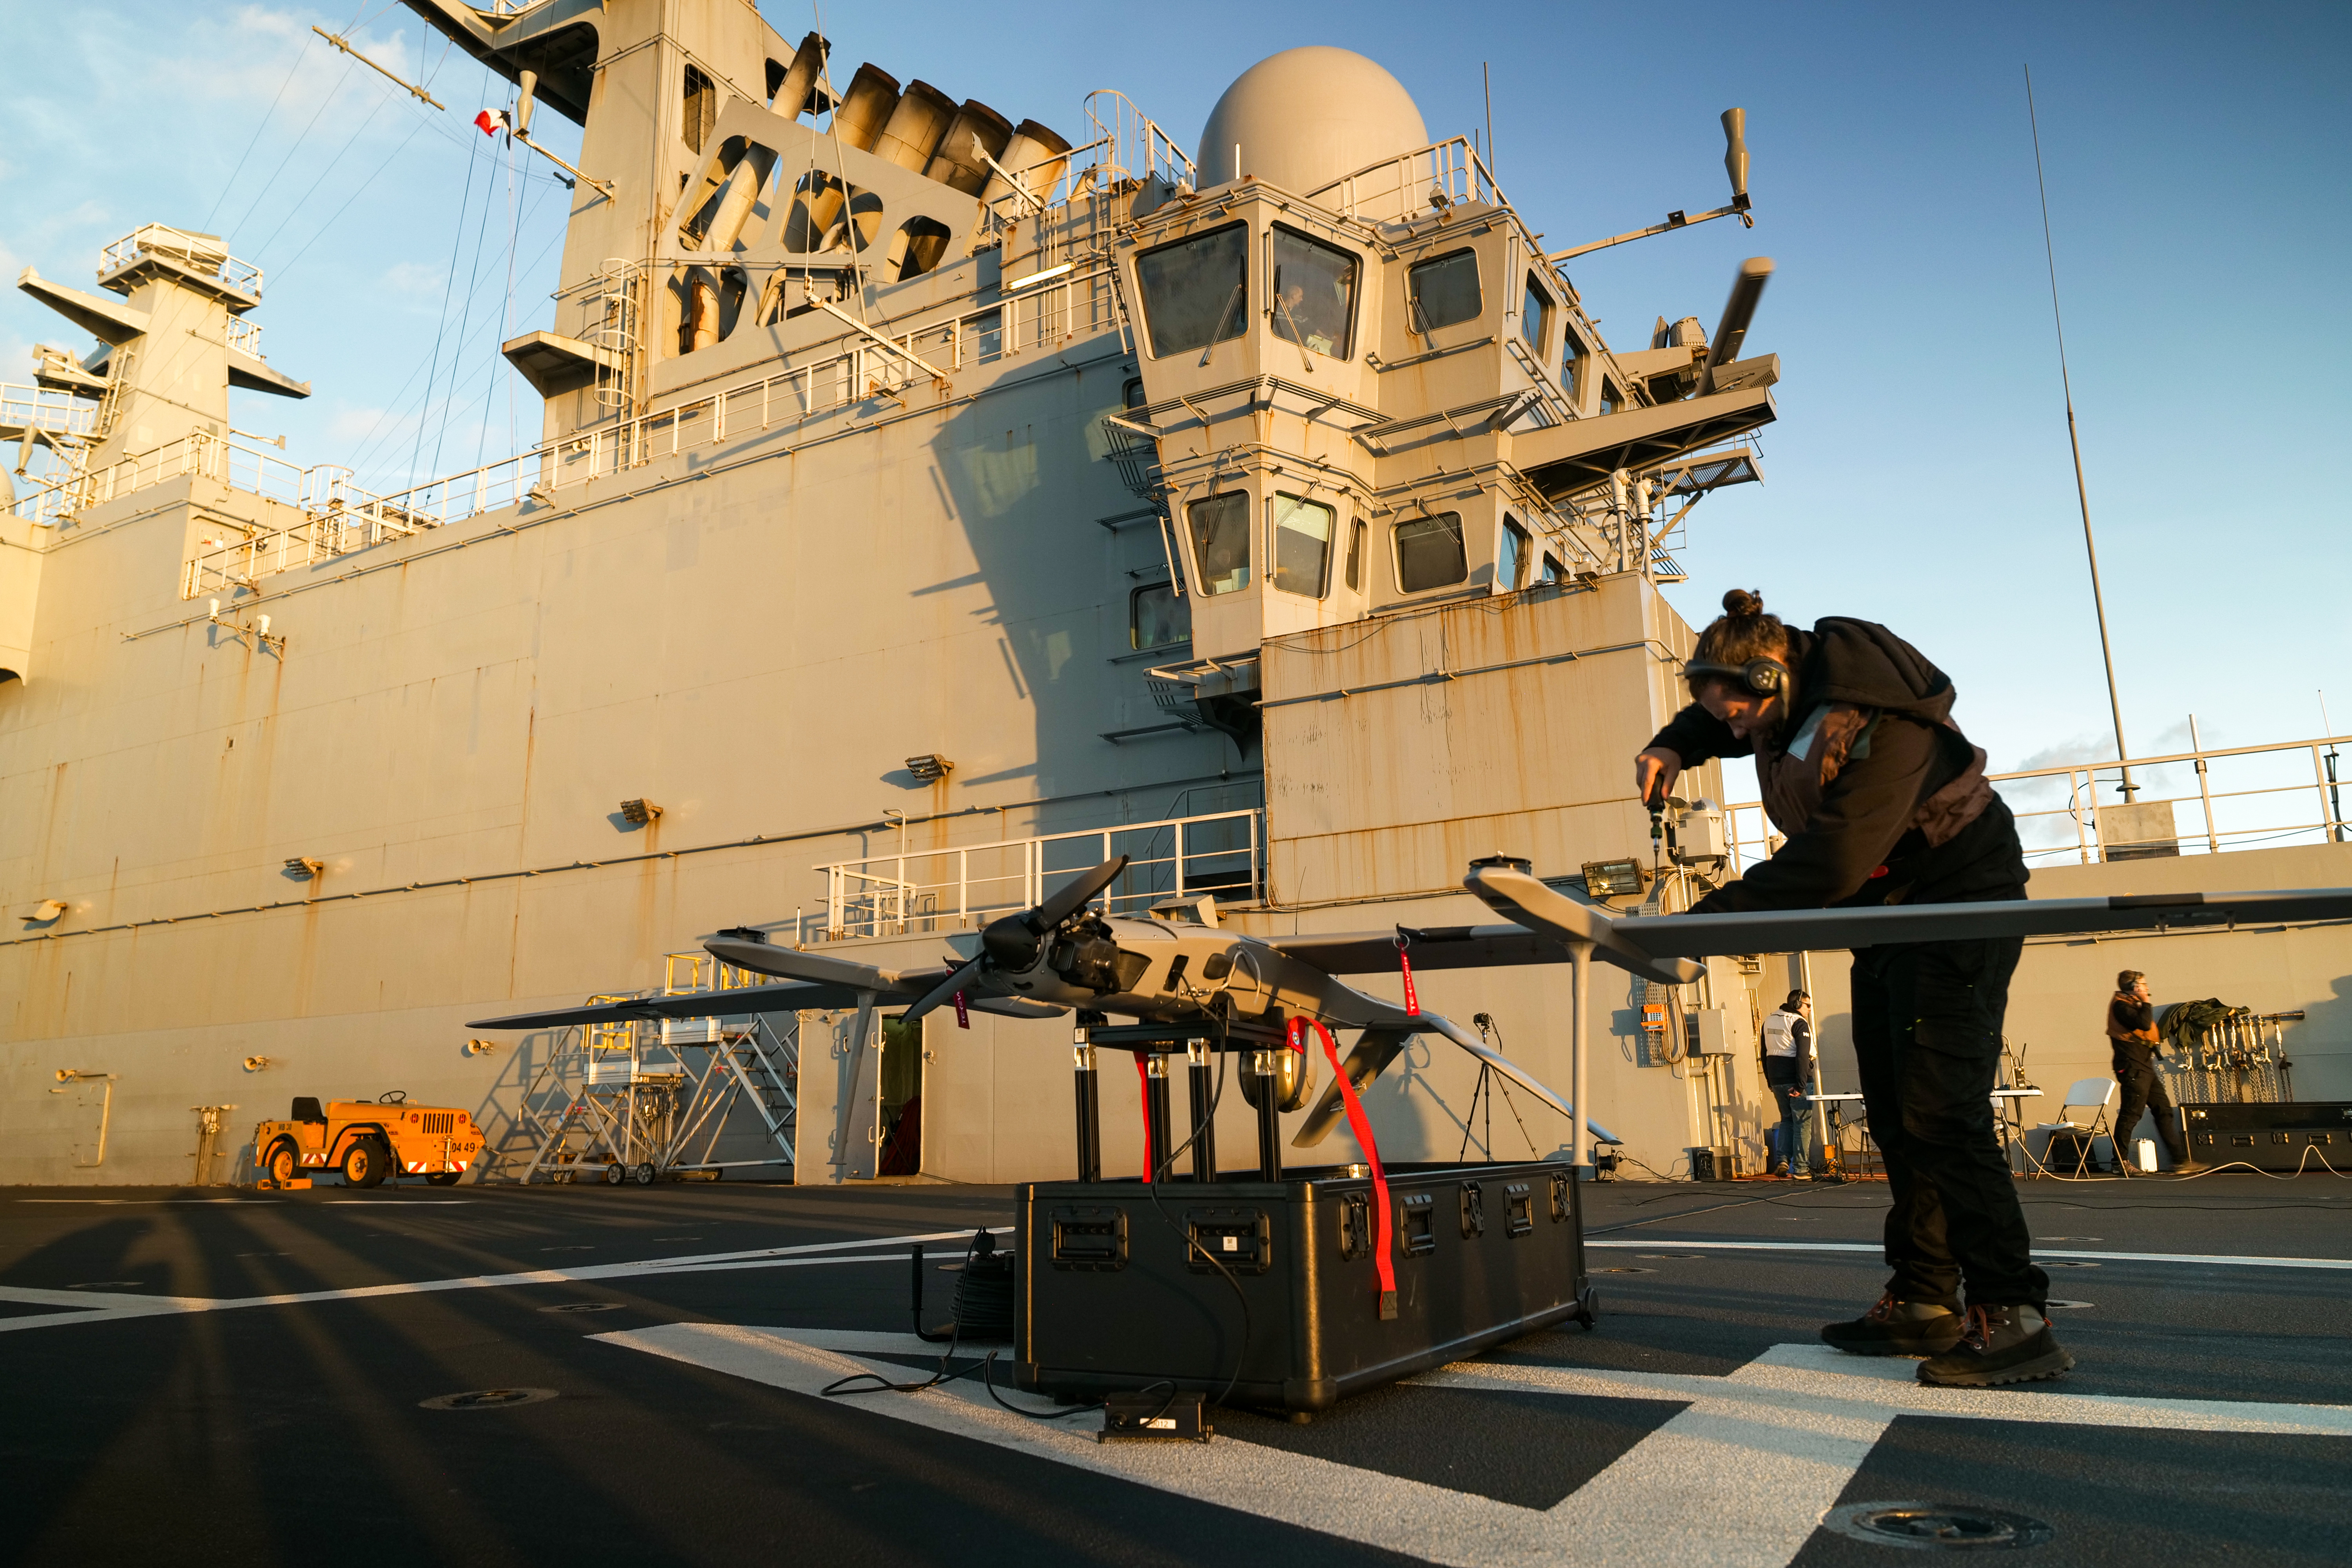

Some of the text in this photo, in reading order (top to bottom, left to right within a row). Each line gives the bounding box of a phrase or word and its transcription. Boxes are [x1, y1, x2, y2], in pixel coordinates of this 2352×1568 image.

[1403, 956, 1416, 1011] TEKEVER
[956, 991, 966, 1024] TEKEV
[452, 1142, 475, 1152] 04 49
